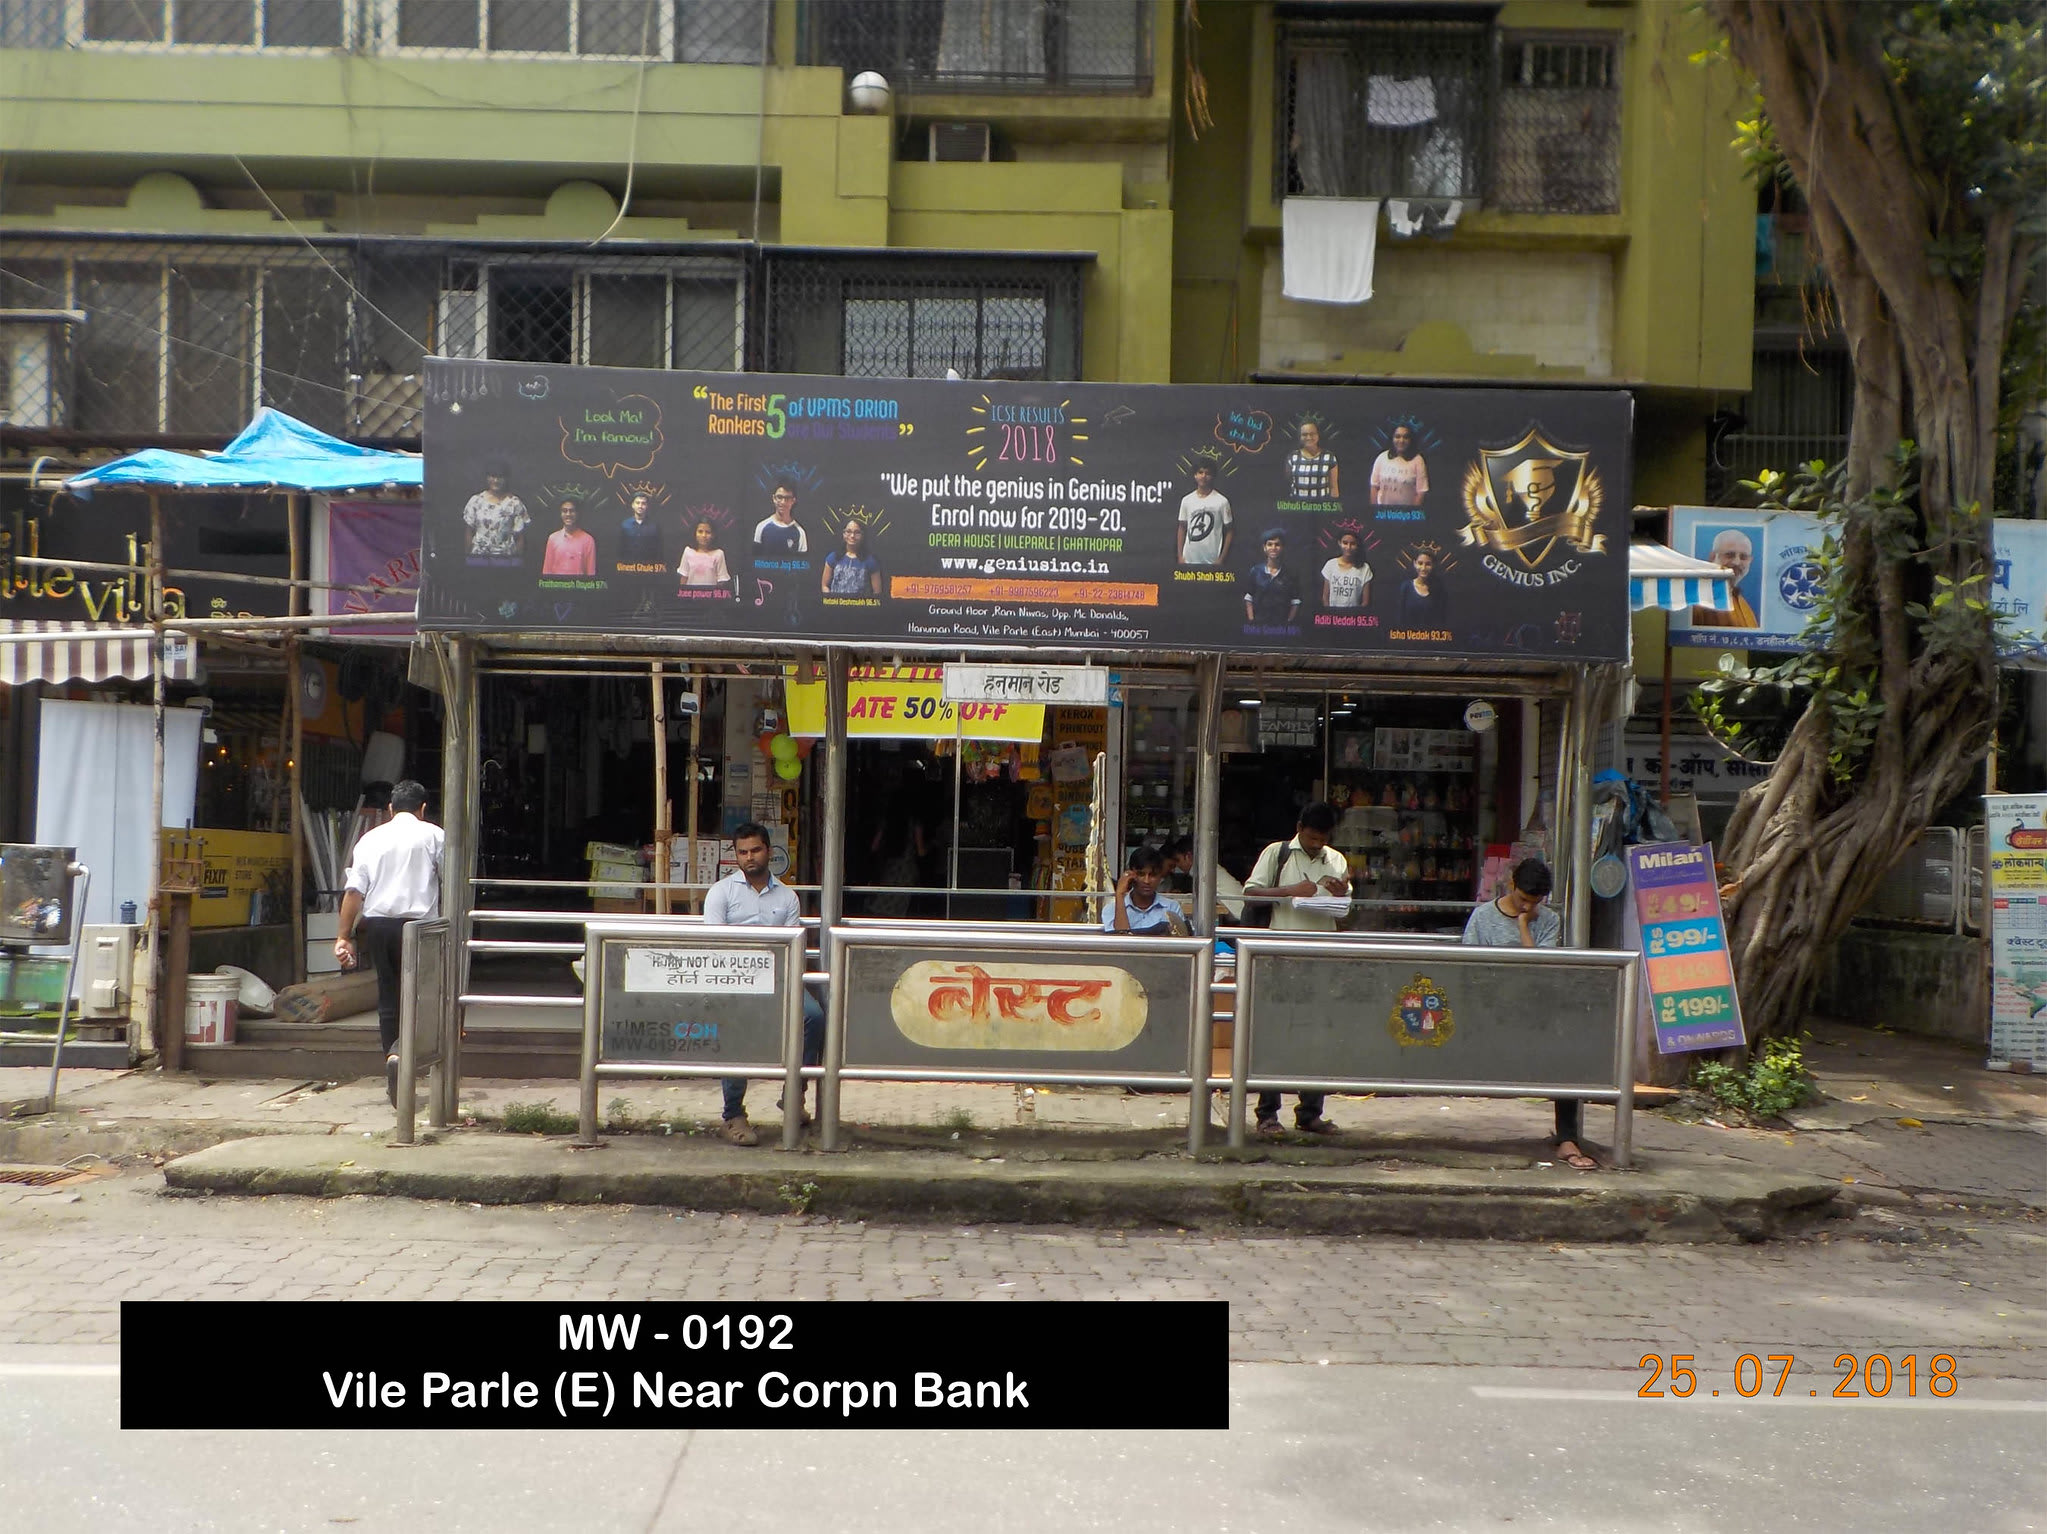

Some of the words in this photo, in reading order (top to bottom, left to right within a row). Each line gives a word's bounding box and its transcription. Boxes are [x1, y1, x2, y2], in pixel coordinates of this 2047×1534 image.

[585, 409, 615, 423] Look
[709, 392, 734, 411] The
[737, 393, 766, 412] First
[766, 394, 786, 439] 5
[788, 397, 804, 417] of
[855, 399, 898, 420] ORION
[992, 404, 1016, 423] ICSE
[1020, 406, 1066, 424] RESULTS
[708, 414, 765, 435] Rankers
[575, 428, 597, 442] I'm
[602, 430, 653, 444] famous!
[998, 424, 1057, 463] 2018
[922, 474, 951, 501] put
[954, 474, 985, 498] the
[988, 476, 1044, 504] genius
[1048, 477, 1065, 499] in
[1068, 478, 1127, 502] Genius
[931, 503, 974, 527] Enrol
[978, 508, 1017, 528] now
[1021, 505, 1045, 529] for
[928, 532, 961, 547] OPERA
[964, 534, 996, 549] HOUSE
[1004, 535, 1055, 550] VILEPARLE
[1063, 537, 1123, 552] GHATKOPAR
[940, 556, 1110, 574] www.geniusinc.in
[1482, 553, 1545, 587] GENIUS
[1549, 559, 1583, 585] INC.
[928, 604, 963, 615] Ground
[966, 605, 988, 616] floor
[1052, 608, 1071, 621] Opp.
[1074, 608, 1087, 619] Mc
[908, 622, 950, 633] Hanuman
[982, 624, 1000, 635] Vile
[1003, 625, 1029, 636] Parle
[1031, 626, 1061, 638] (East)
[1064, 627, 1100, 638] Mumbai
[1110, 630, 1149, 640] 400057
[1037, 670, 1065, 695] रोड
[904, 696, 954, 721] 50%
[960, 702, 1009, 721] OFF
[1060, 708, 1094, 720] XEROX
[1259, 719, 1315, 733] FAMILY
[1640, 850, 1704, 870] Milan
[1666, 927, 1718, 949] 99/-
[686, 955, 709, 969] NOT
[712, 956, 727, 969] OK
[730, 957, 770, 969] PLEASE
[1678, 995, 1730, 1018] 199/-
[614, 1019, 671, 1037] TIMES
[674, 1021, 718, 1040] OOH
